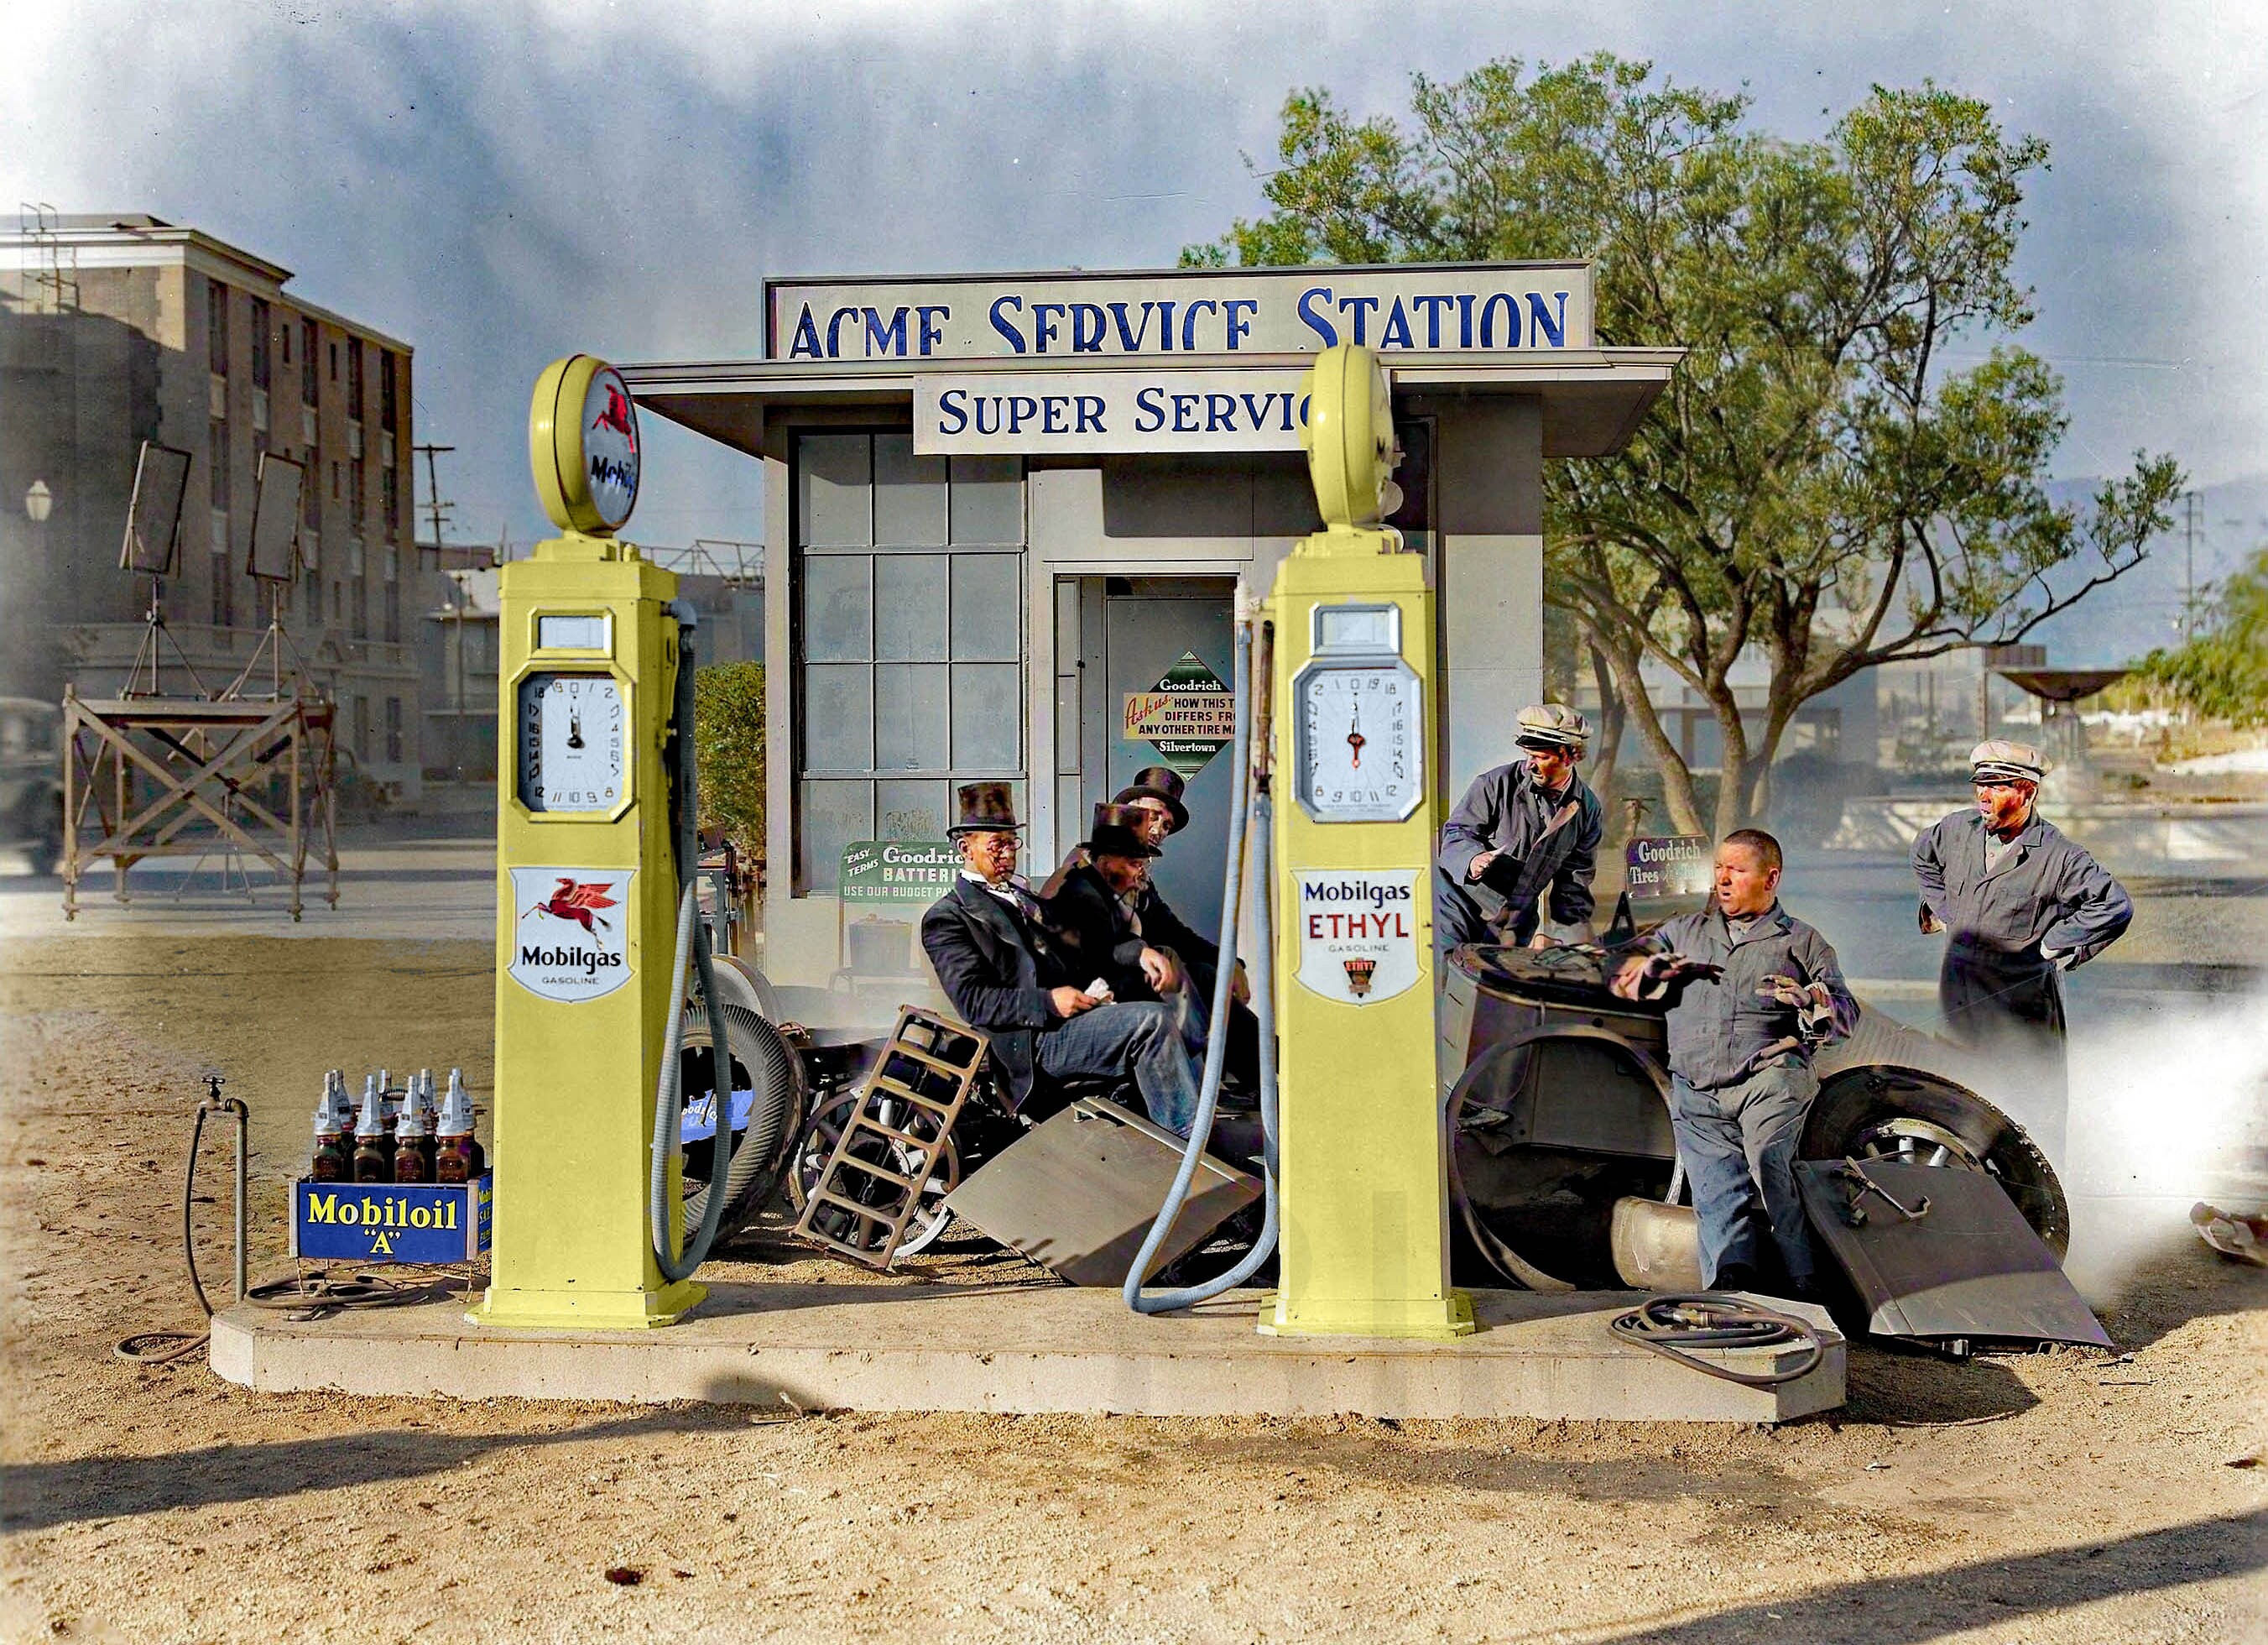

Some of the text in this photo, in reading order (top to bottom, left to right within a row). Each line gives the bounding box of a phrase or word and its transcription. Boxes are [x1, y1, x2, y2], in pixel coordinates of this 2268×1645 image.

[789, 288, 1569, 358] ACME SERVICE STATION
[938, 389, 1108, 436] SUPER
[1159, 678, 1223, 692] Goodrich
[1124, 697, 1154, 729] Ask
[1174, 697, 1199, 708] HOW
[1202, 697, 1226, 708] THIS
[1165, 711, 1236, 722] DIFFERS FR
[1138, 724, 1161, 734] ANY
[1161, 724, 1196, 734] OTHER
[1197, 724, 1220, 734] TIRE
[1159, 740, 1217, 752] Silvertown
[847, 846, 965, 864] EASY Goodric
[1638, 838, 1701, 864] Goodrich
[847, 859, 957, 883] TERMS BATTERI
[1629, 865, 1659, 885] Tires
[843, 885, 863, 896] USE
[867, 886, 889, 897] OUR
[892, 886, 934, 897] BUDGET
[1305, 881, 1410, 909] Mobilgas
[1309, 913, 1409, 939] ETHYL
[1328, 943, 1389, 953] GASOLINE
[521, 946, 621, 974] Mobilgas
[541, 976, 600, 985] GASOLINE
[307, 1193, 457, 1230] Mobiloil
